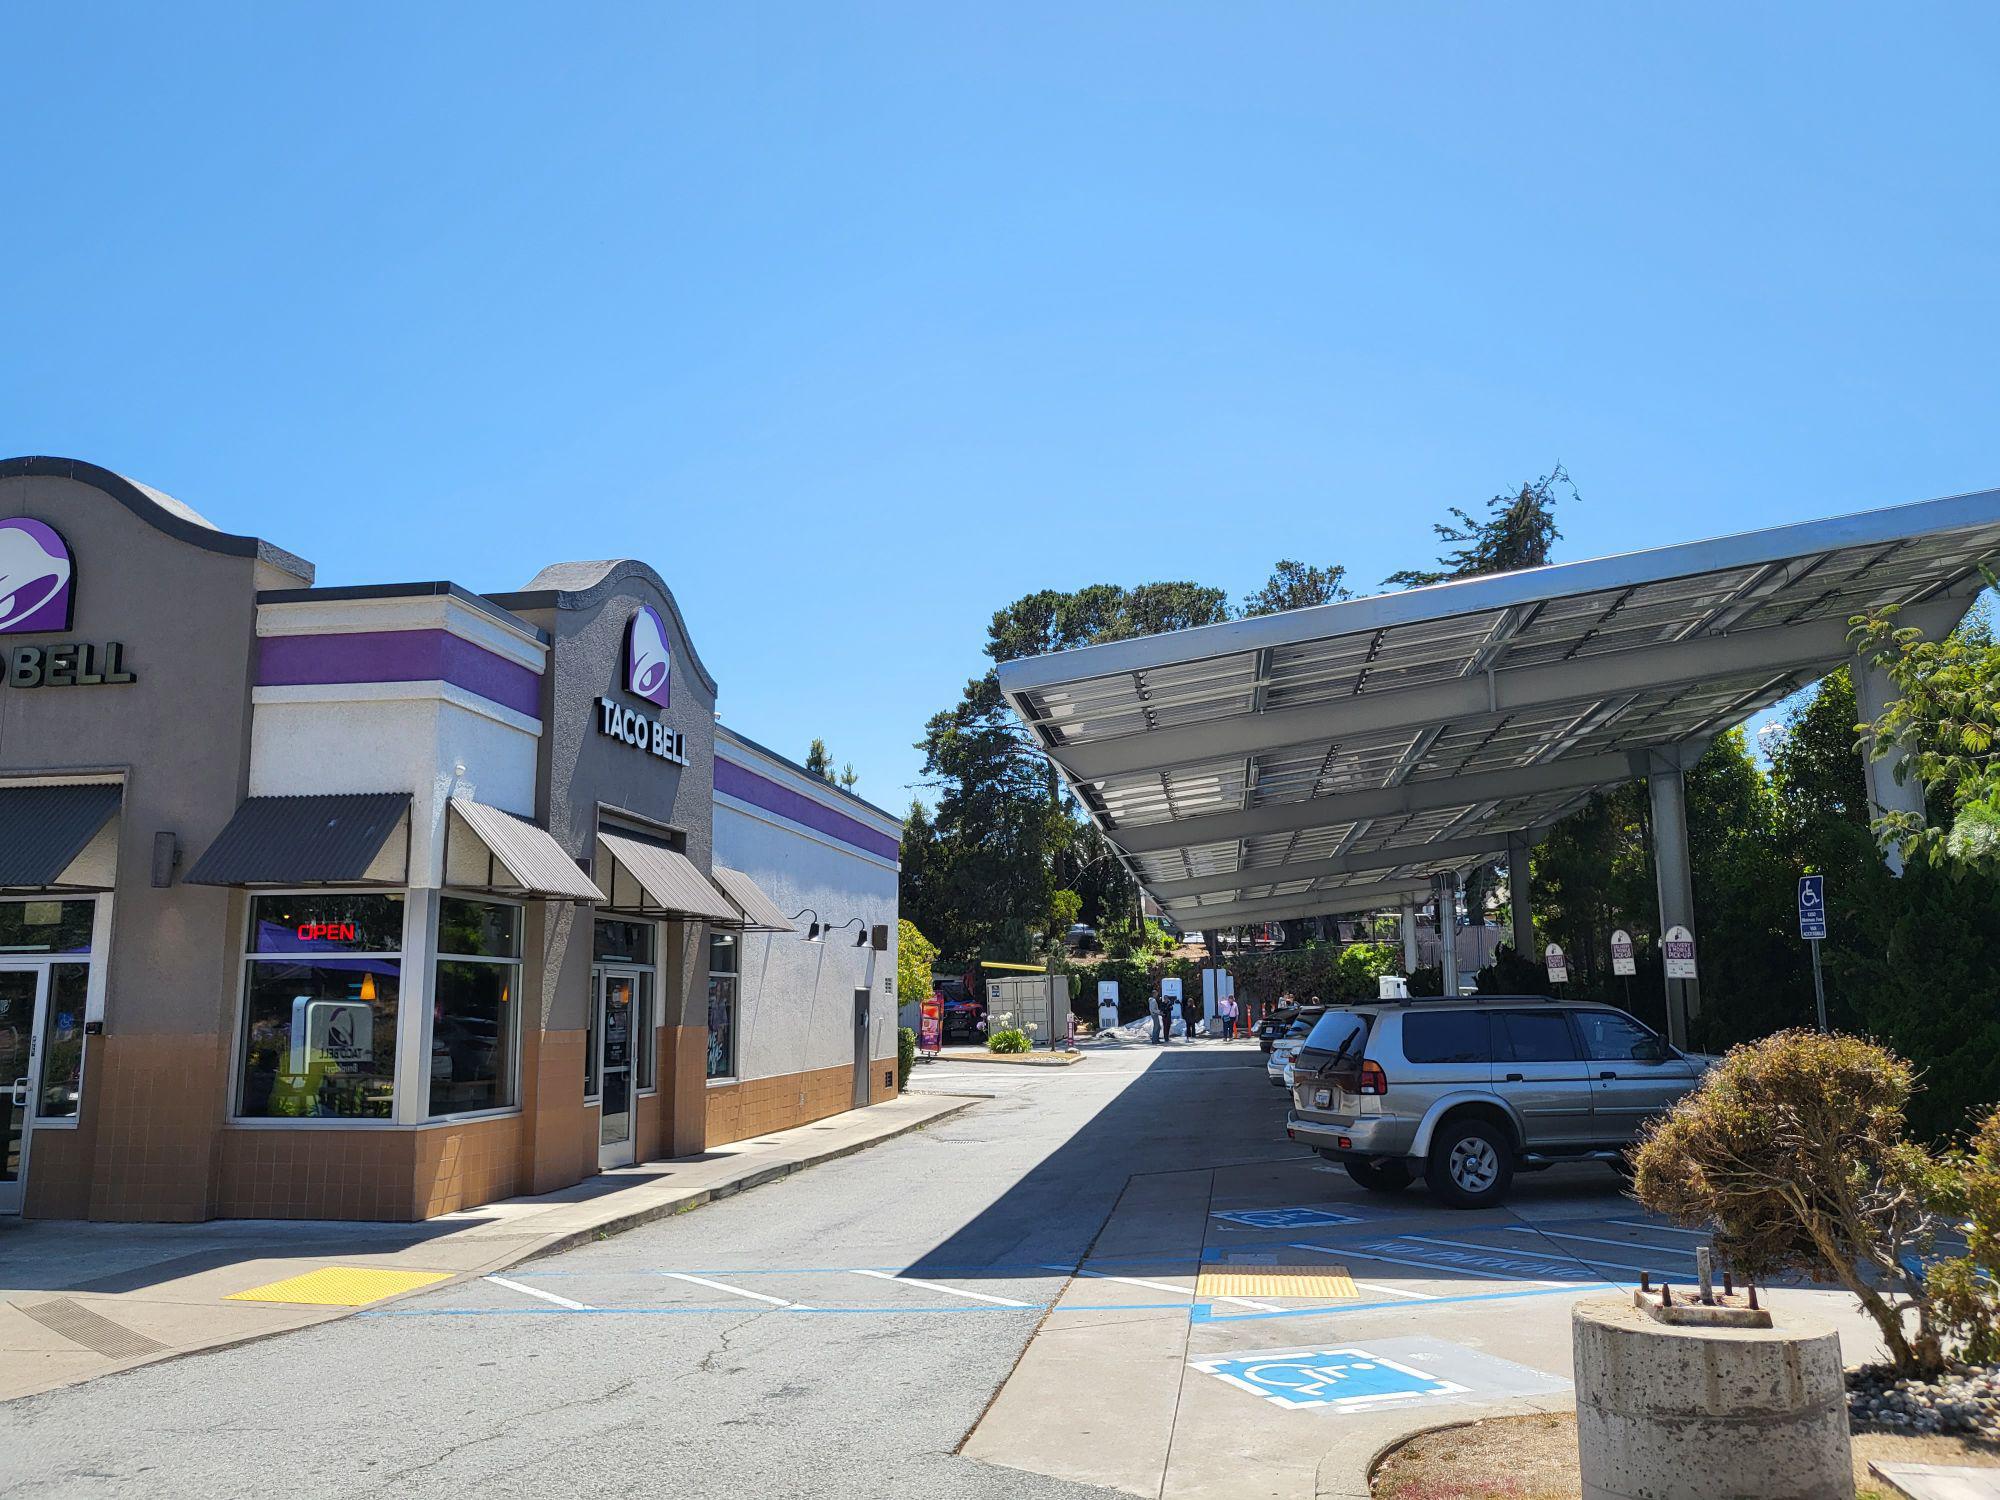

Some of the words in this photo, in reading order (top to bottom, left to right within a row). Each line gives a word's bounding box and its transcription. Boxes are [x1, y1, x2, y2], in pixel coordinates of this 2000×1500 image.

[10, 642, 136, 688] BELL
[599, 697, 649, 750] TACO
[652, 722, 691, 767] BELL
[297, 923, 355, 941] OPEN
